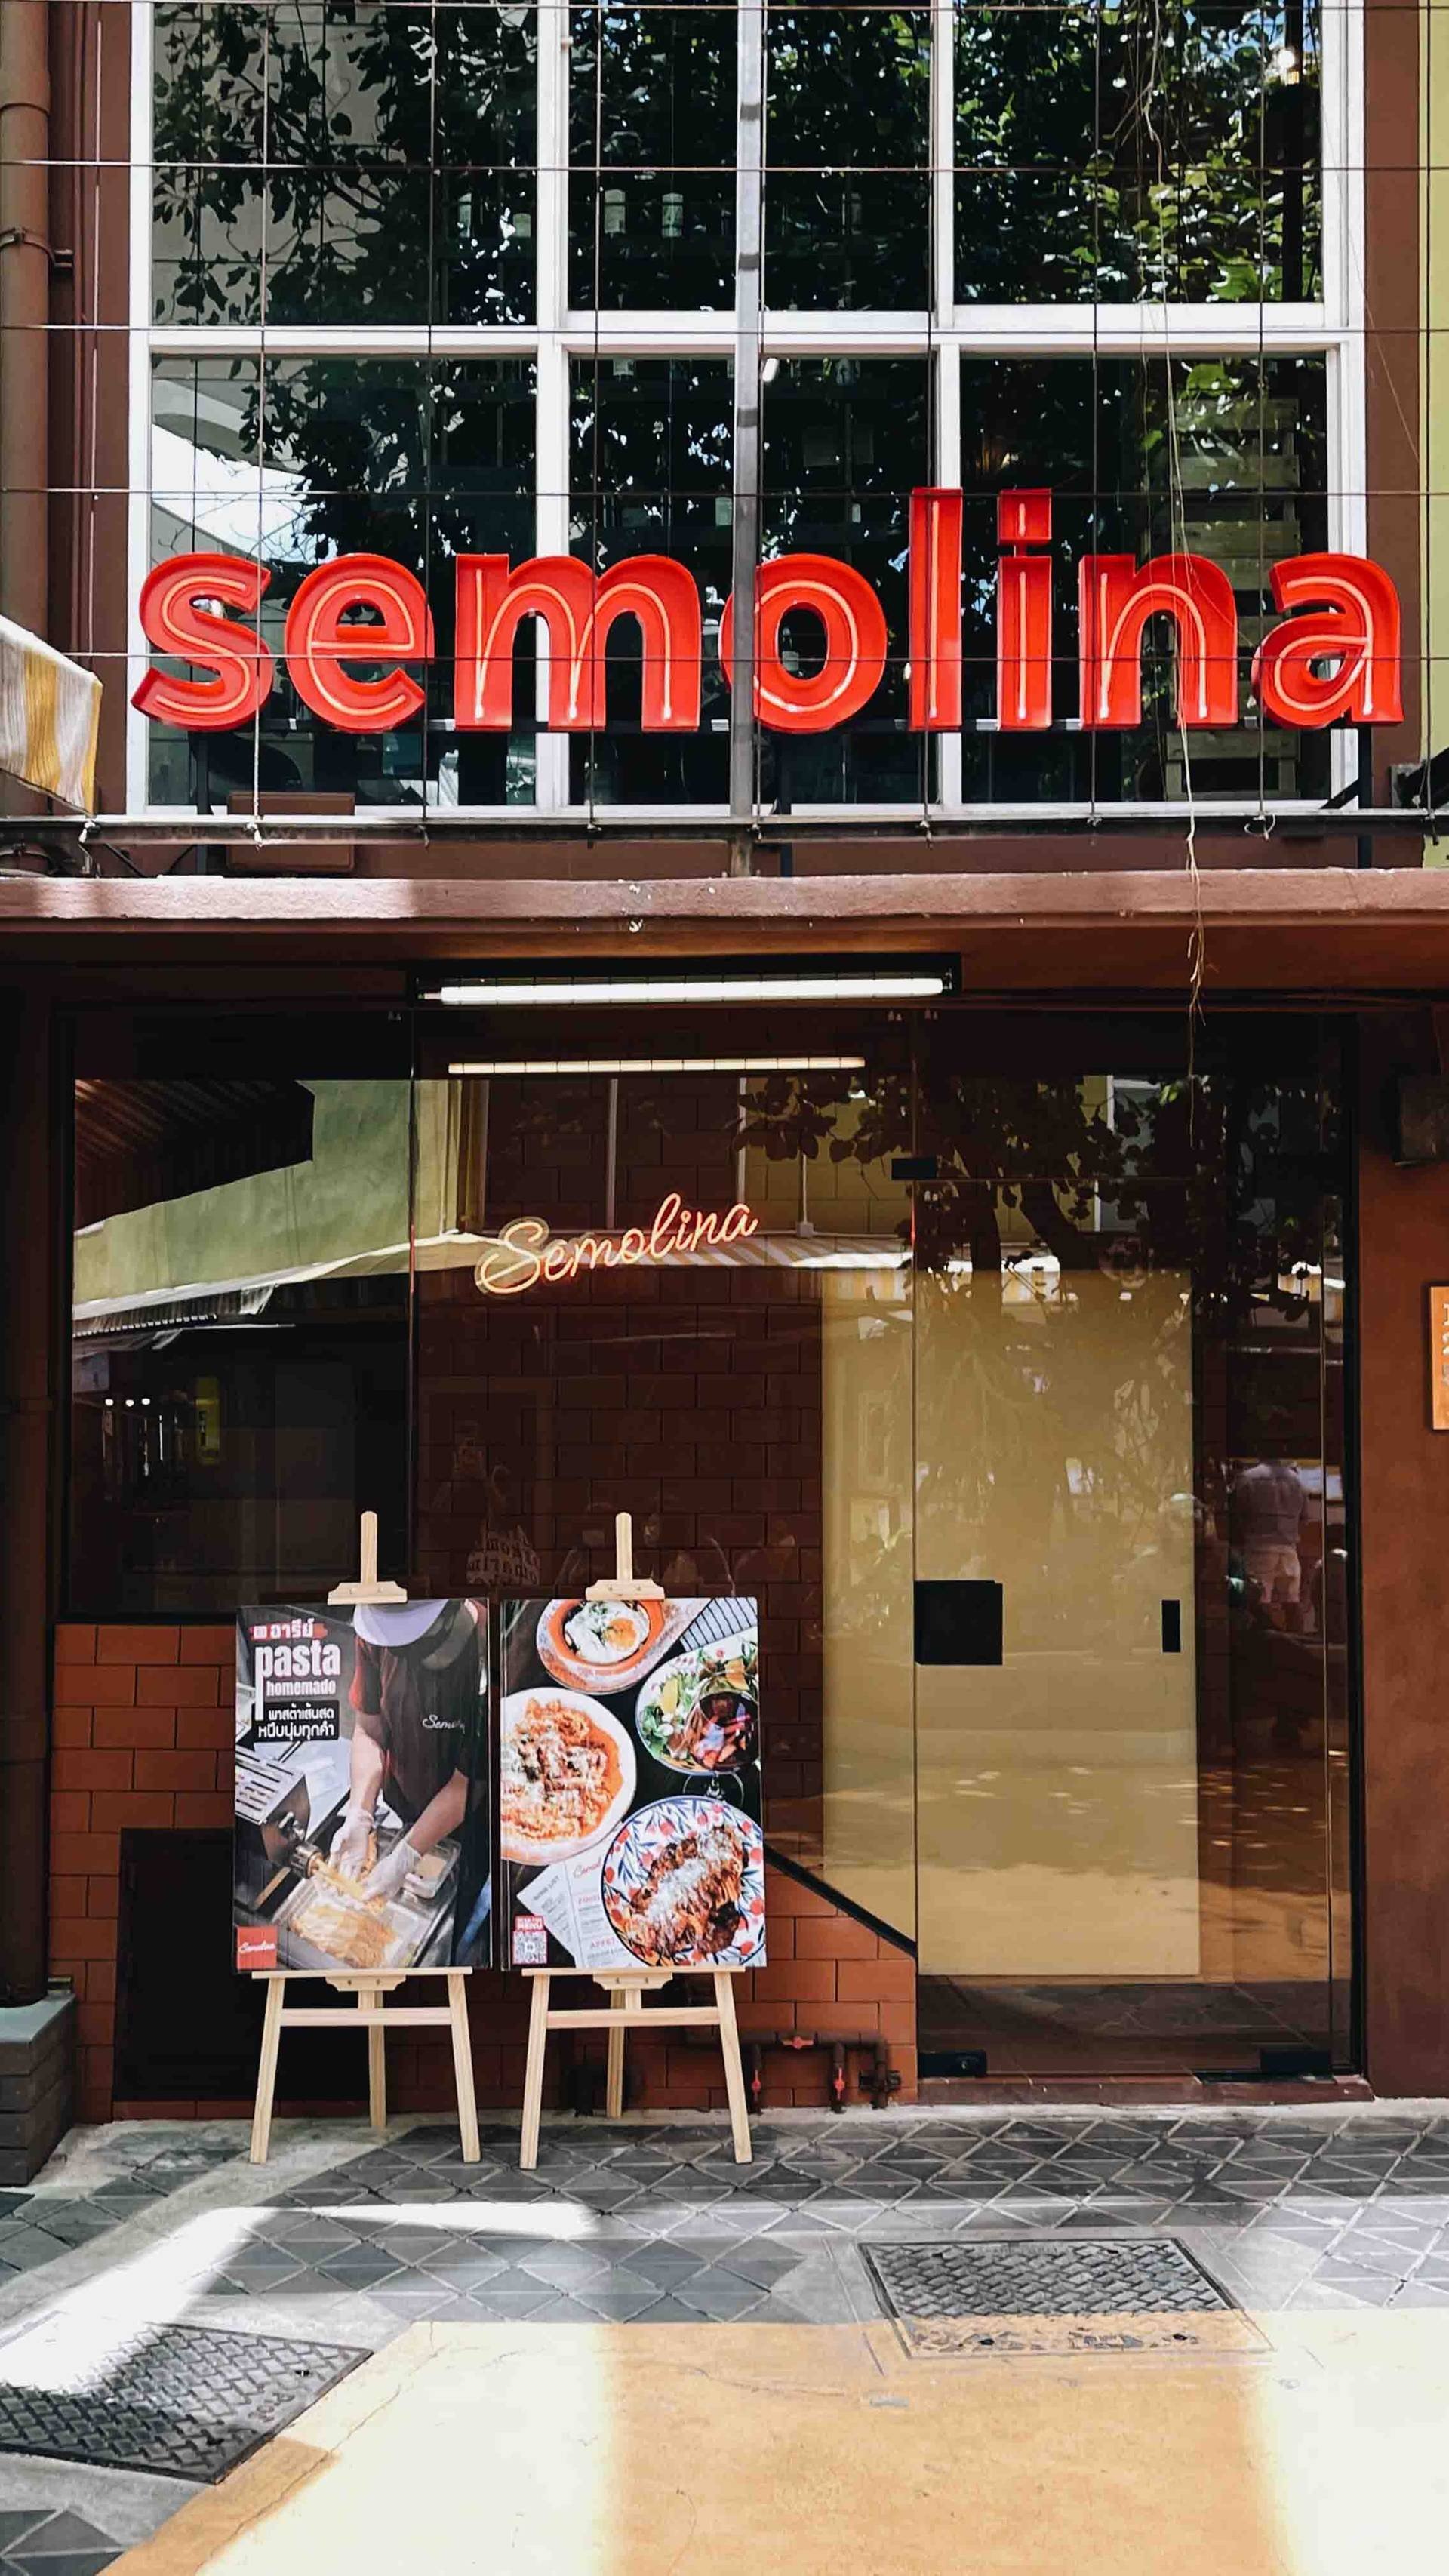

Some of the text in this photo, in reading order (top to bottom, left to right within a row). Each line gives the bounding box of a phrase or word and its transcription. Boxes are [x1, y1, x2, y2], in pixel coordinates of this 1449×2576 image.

[131, 485, 1404, 735] semolina
[475, 1193, 758, 1296] Semolina
[254, 1639, 341, 1722] pasta
[266, 1679, 337, 1697] homemade
